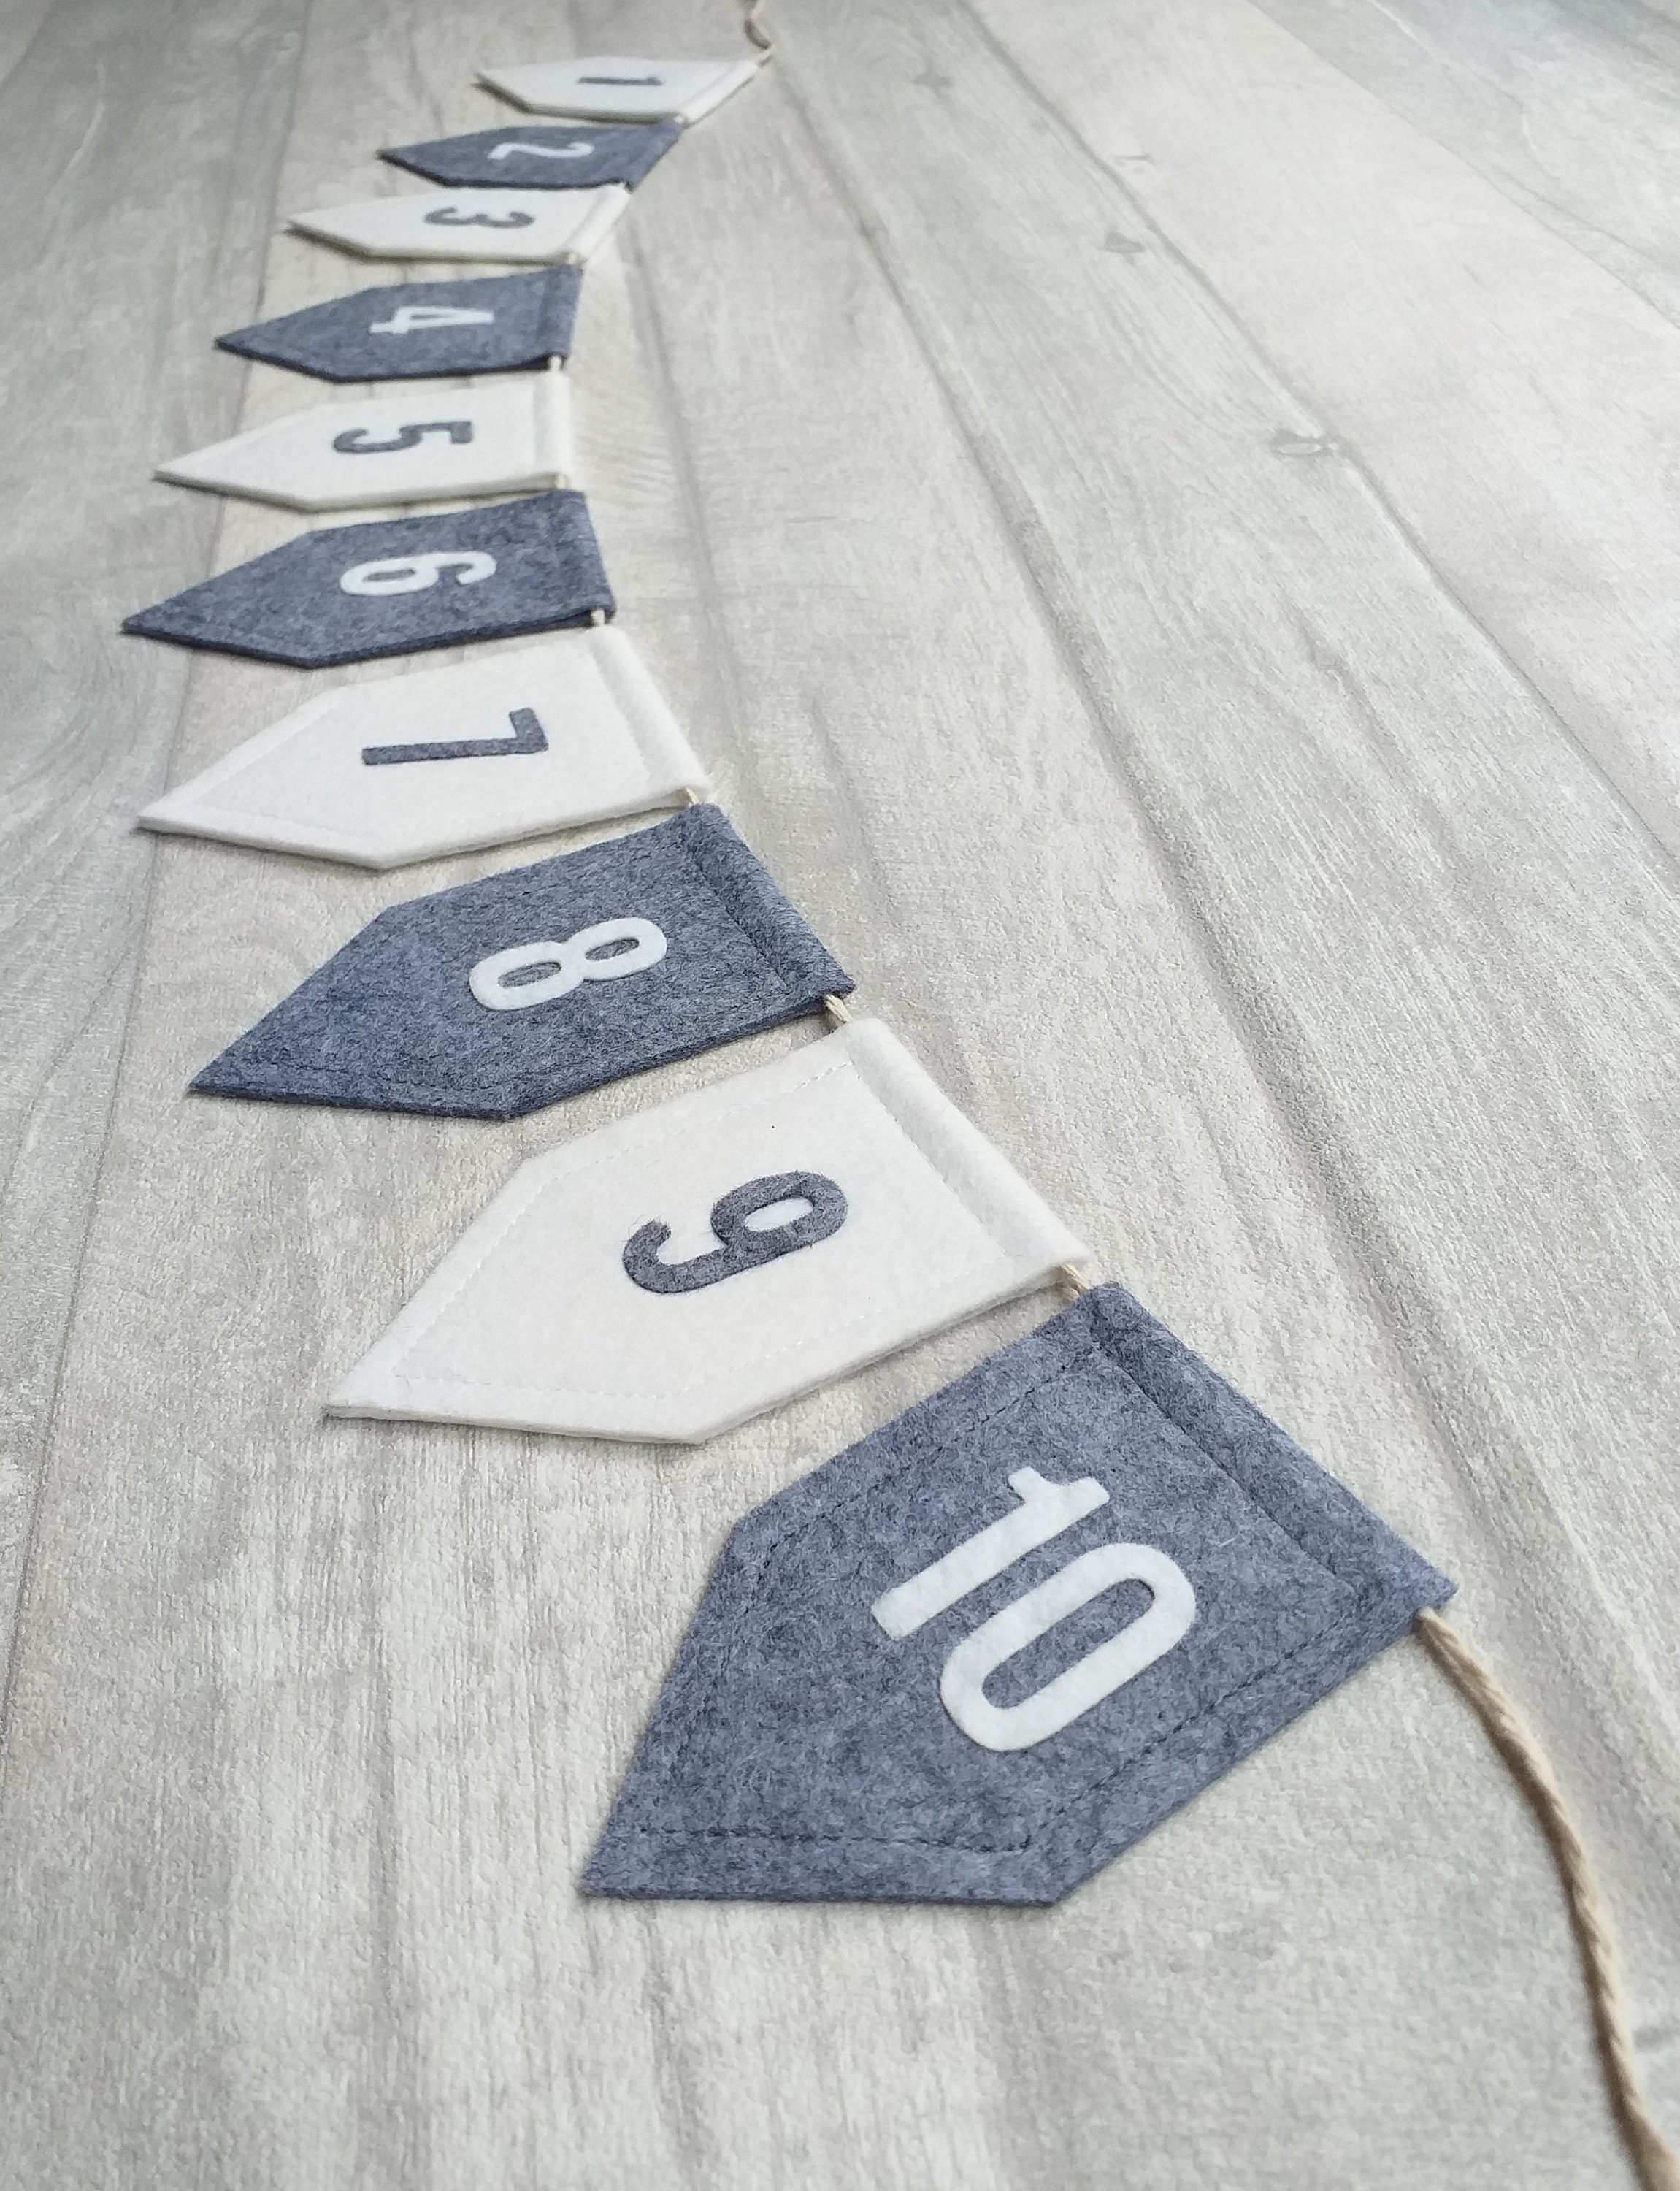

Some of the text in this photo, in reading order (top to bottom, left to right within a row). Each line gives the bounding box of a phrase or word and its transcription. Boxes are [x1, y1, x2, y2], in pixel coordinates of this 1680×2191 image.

[577, 75, 664, 86] 1
[488, 141, 595, 160] 2
[423, 205, 534, 230] 3
[369, 304, 496, 337] 4
[334, 421, 473, 454] 5
[339, 550, 497, 597] 6
[361, 707, 548, 767] 7
[469, 917, 668, 1010] 8
[622, 1170, 848, 1294] 9
[872, 1466, 1197, 1752] 10
